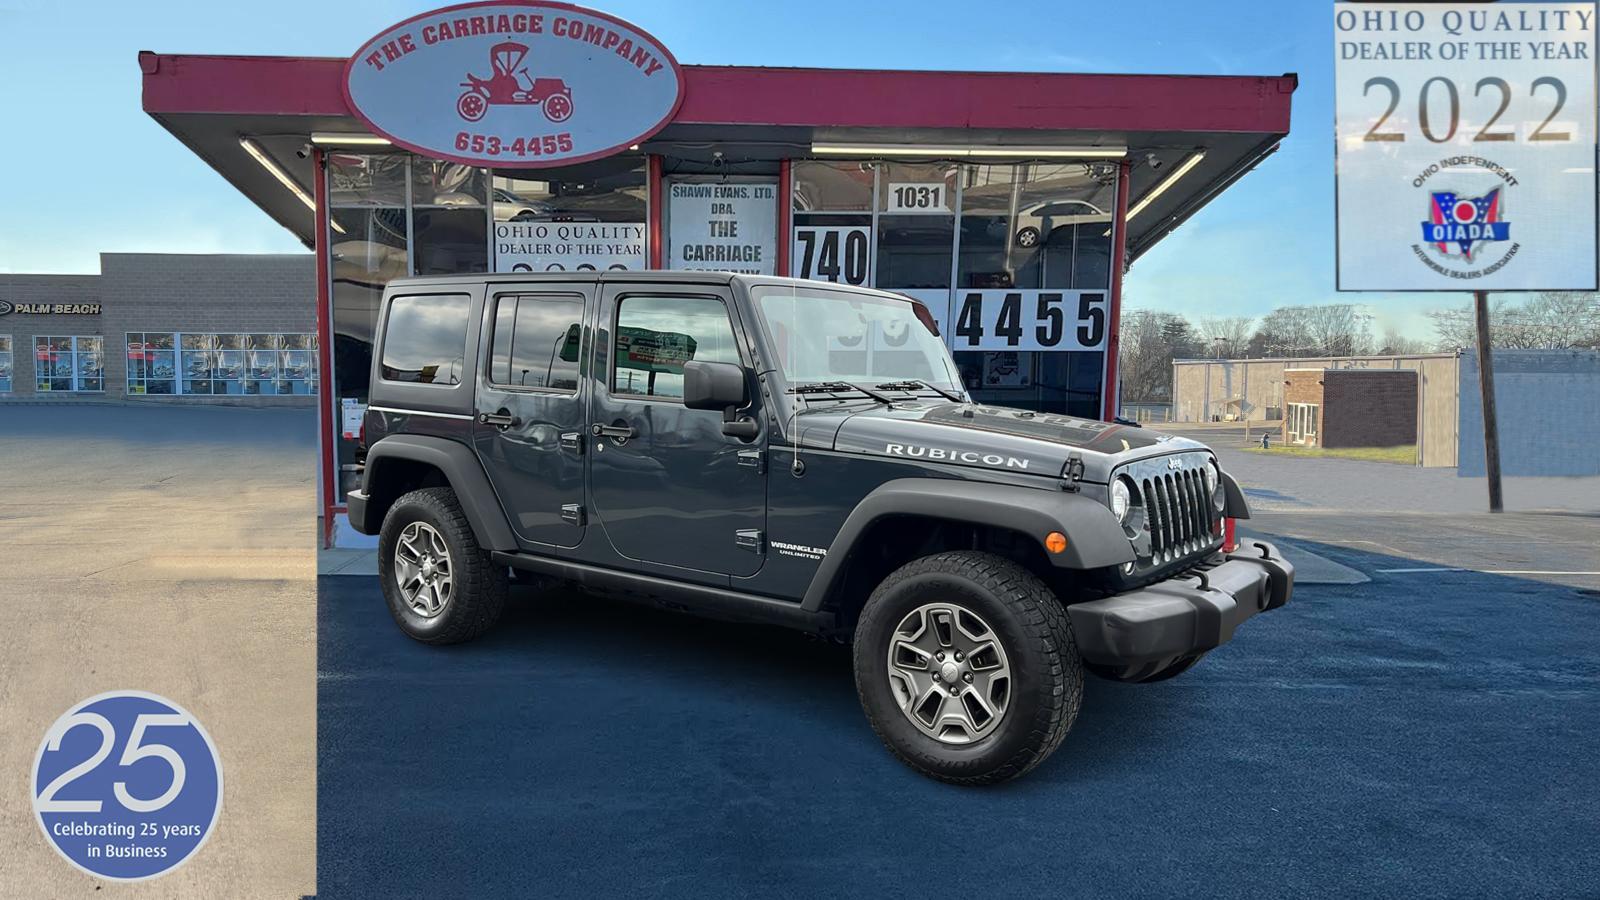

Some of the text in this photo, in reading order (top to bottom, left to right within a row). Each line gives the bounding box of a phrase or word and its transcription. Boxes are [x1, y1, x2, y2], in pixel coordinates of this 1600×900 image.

[1336, 10, 1592, 35] OHIO QUALITY
[366, 14, 664, 77] THE CARRIAGE COMPANY
[1340, 42, 1589, 60] DEALER OF THE YEAR
[1363, 76, 1571, 143] 2022
[454, 132, 573, 156] 653-4455
[1412, 156, 1519, 188] OHIO INDEPENDENT
[673, 186, 711, 198] SHAWN
[754, 187, 774, 199] LTD.
[894, 186, 940, 208] 1031
[711, 203, 736, 215] DBA.
[497, 226, 643, 240] OHIO QUALITY
[708, 221, 738, 237] THE
[1432, 224, 1496, 241] OIADA
[500, 243, 641, 255] DEALER OF THE YEAR
[683, 244, 762, 262] CARRIAGE
[797, 230, 868, 285] 740
[15, 304, 100, 314] PALM BEACH
[886, 443, 1030, 469] RUBICON
[1169, 458, 1182, 471] Jeep
[770, 541, 827, 555] WRANGLER
[779, 549, 820, 560] UNLIMITED
